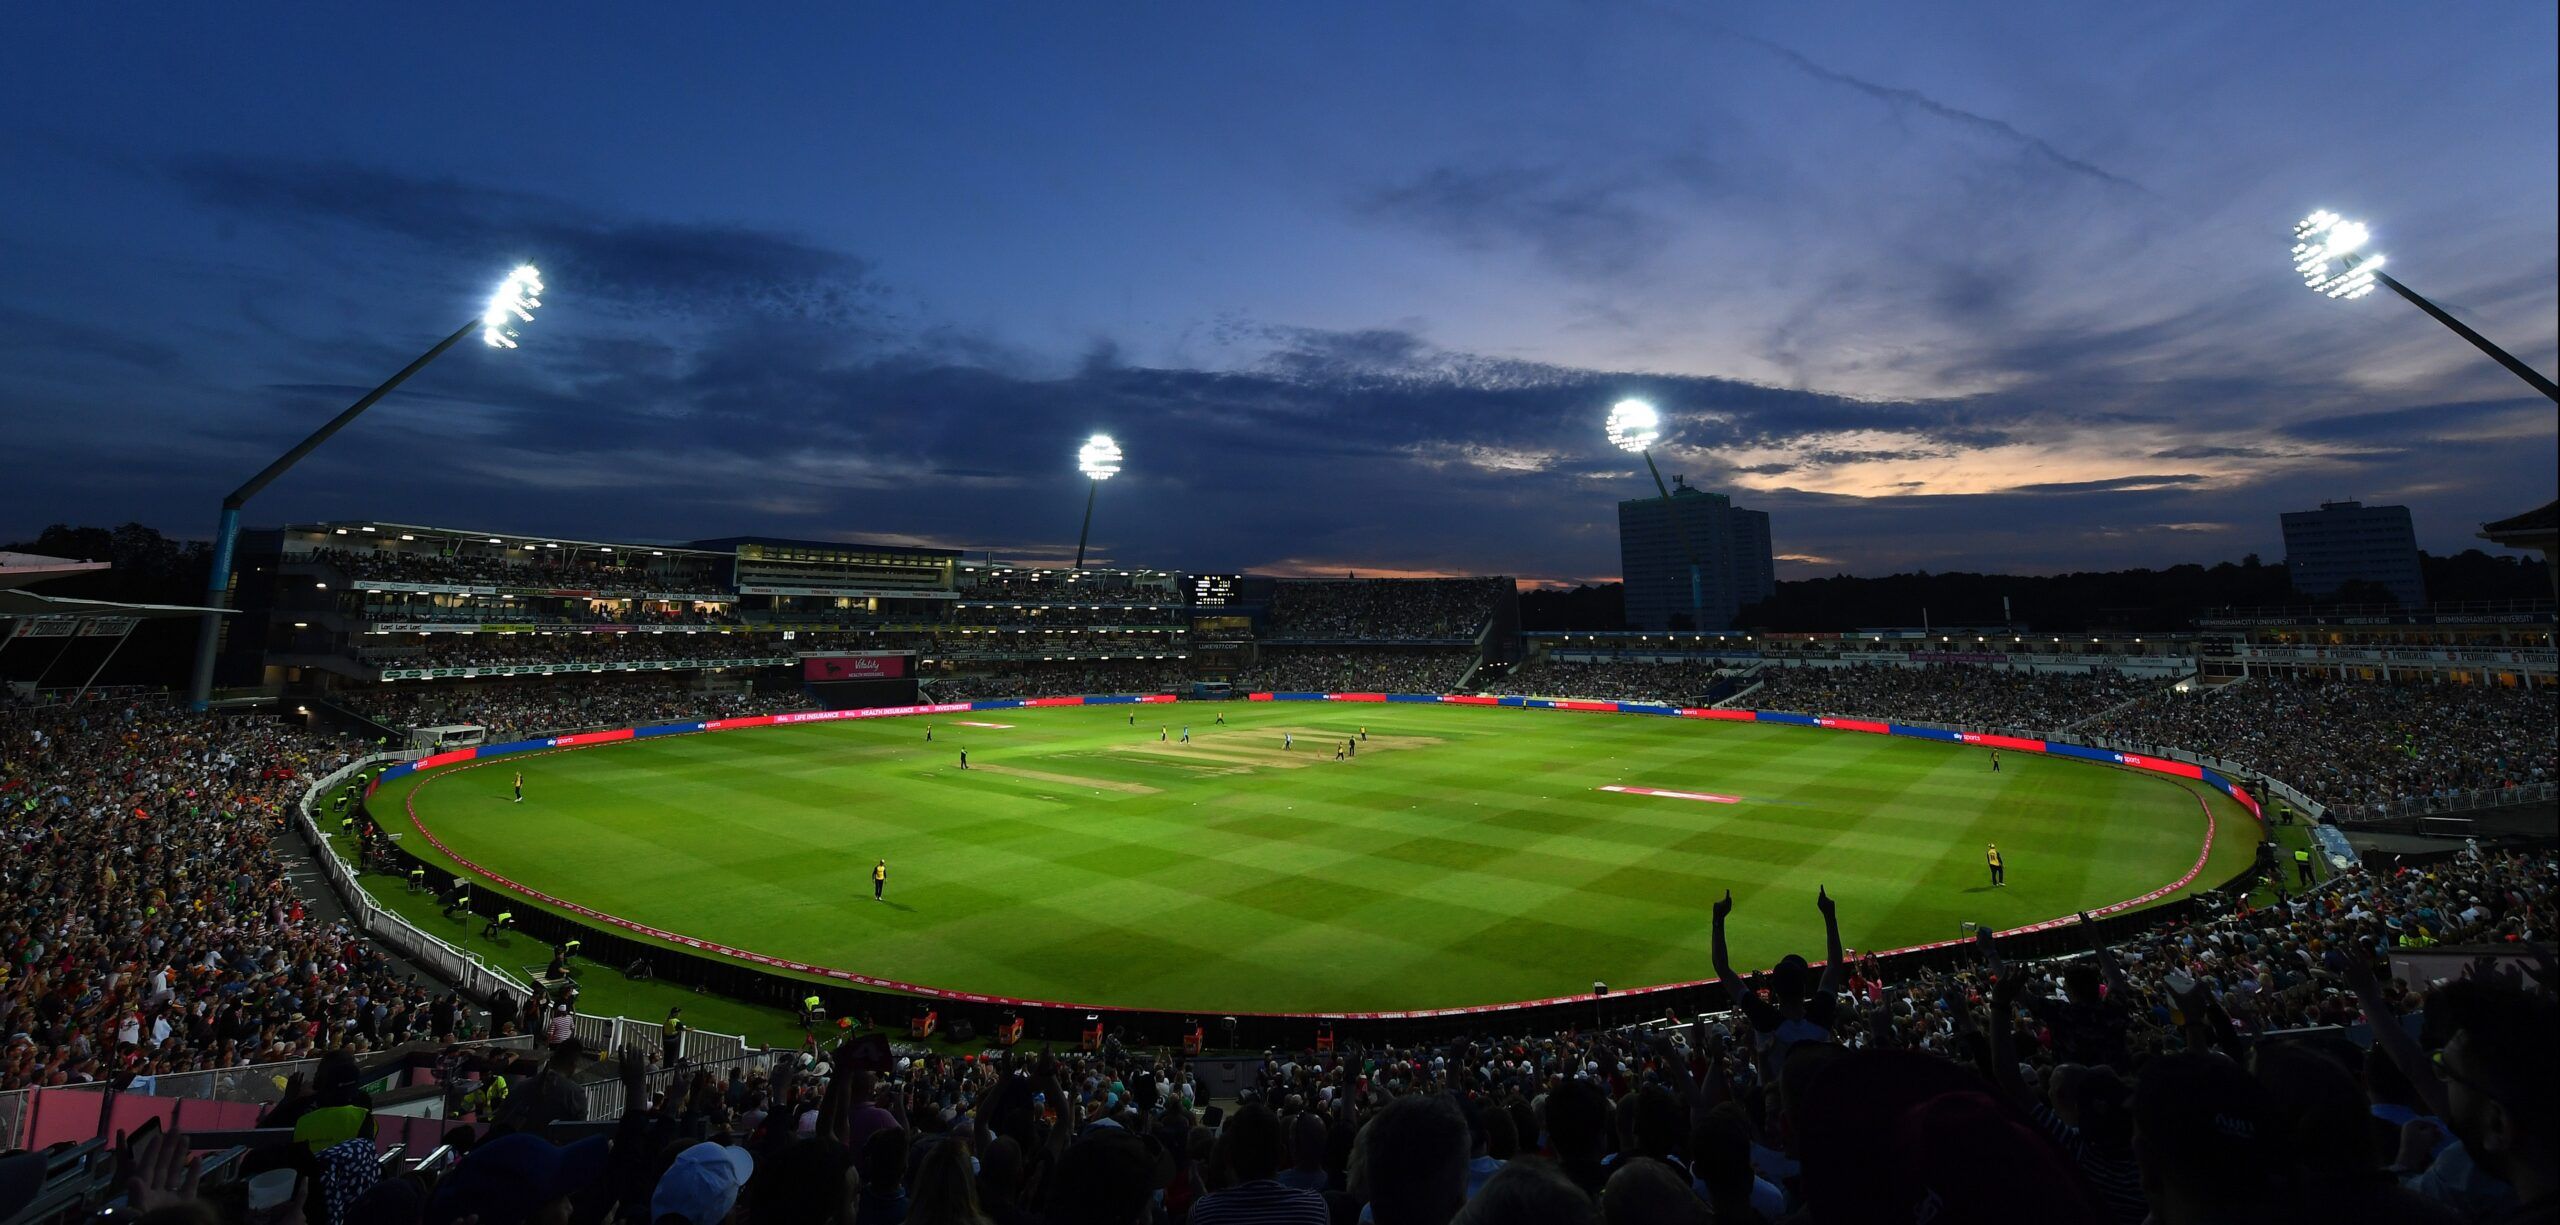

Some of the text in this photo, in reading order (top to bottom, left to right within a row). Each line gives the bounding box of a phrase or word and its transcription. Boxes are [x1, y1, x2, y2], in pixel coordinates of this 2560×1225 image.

[2435, 616, 2482, 624] BIRMINGHAM
[2498, 615, 2534, 623] UNIVERSITY
[855, 658, 880, 670] Vitality
[934, 703, 969, 711] INVESTMENTS
[806, 711, 839, 720] INSURANCE
[1953, 732, 1963, 741] sky
[547, 738, 557, 746] sky
[2114, 753, 2141, 765] sky sports
